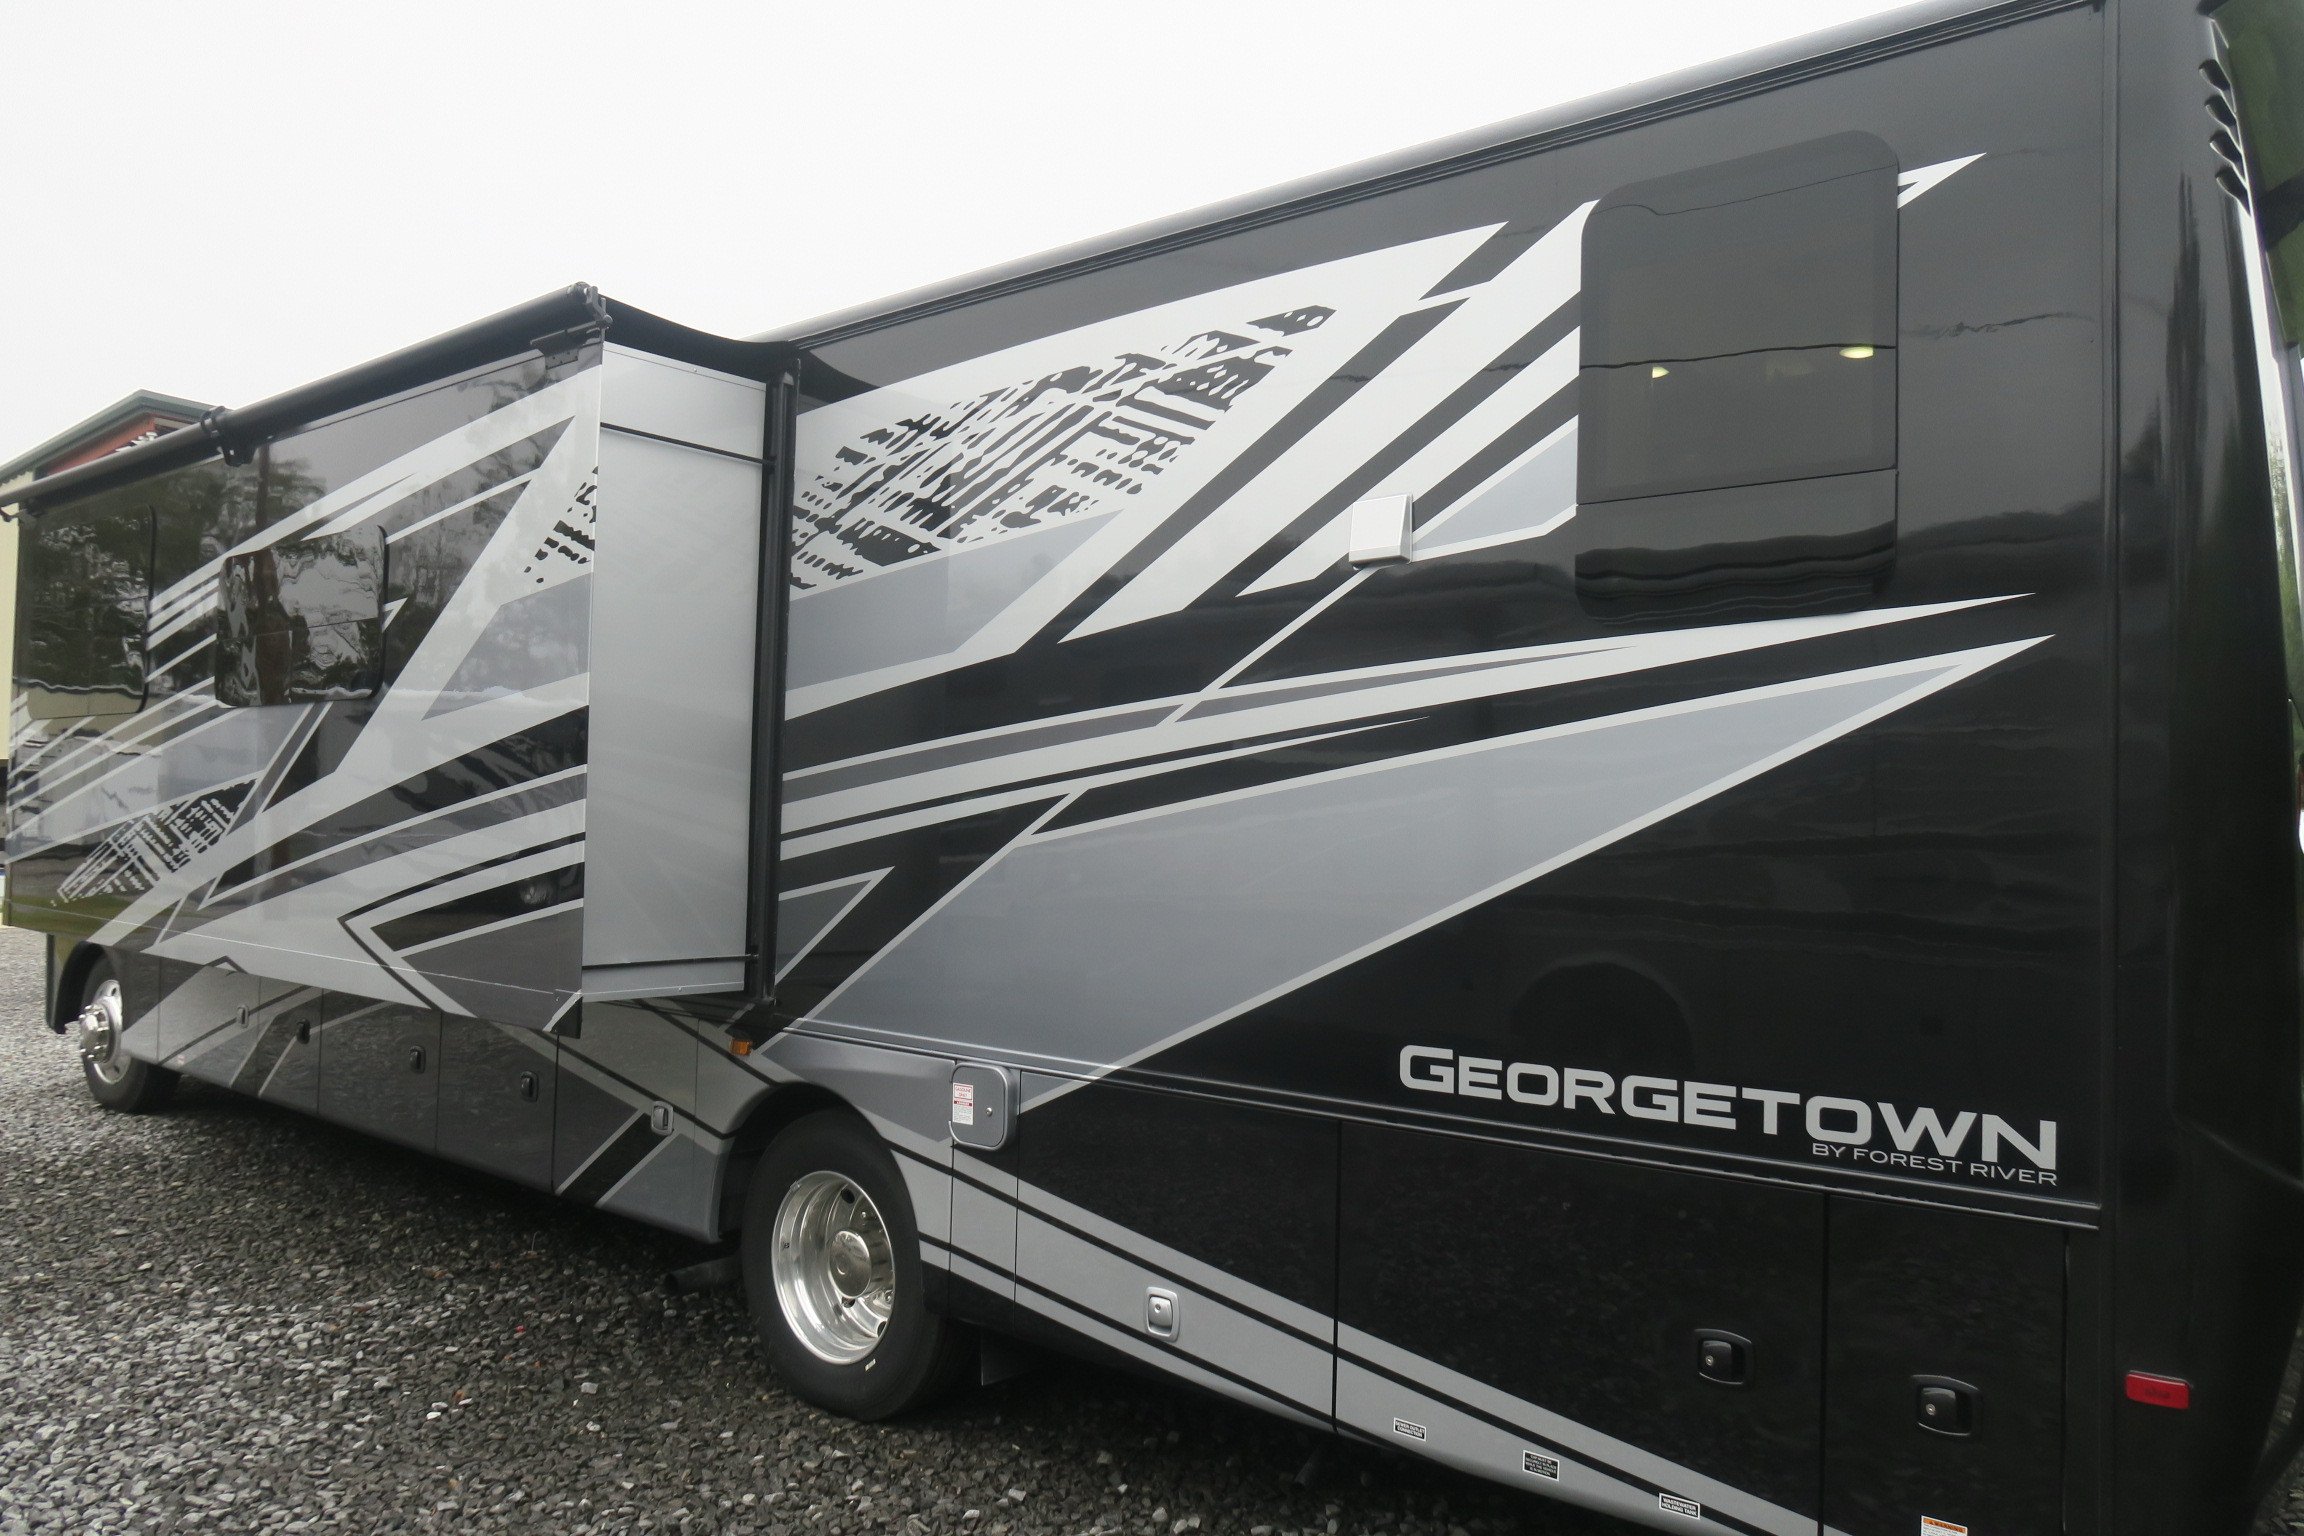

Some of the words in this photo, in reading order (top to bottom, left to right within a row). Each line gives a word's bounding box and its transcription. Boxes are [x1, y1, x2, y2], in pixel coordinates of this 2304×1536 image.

[1399, 1044, 2057, 1170] GEORGETOWN
[1812, 1142, 1846, 1159] BY
[1853, 1147, 1963, 1173] FOREST
[1970, 1163, 2058, 1187] RIVER
